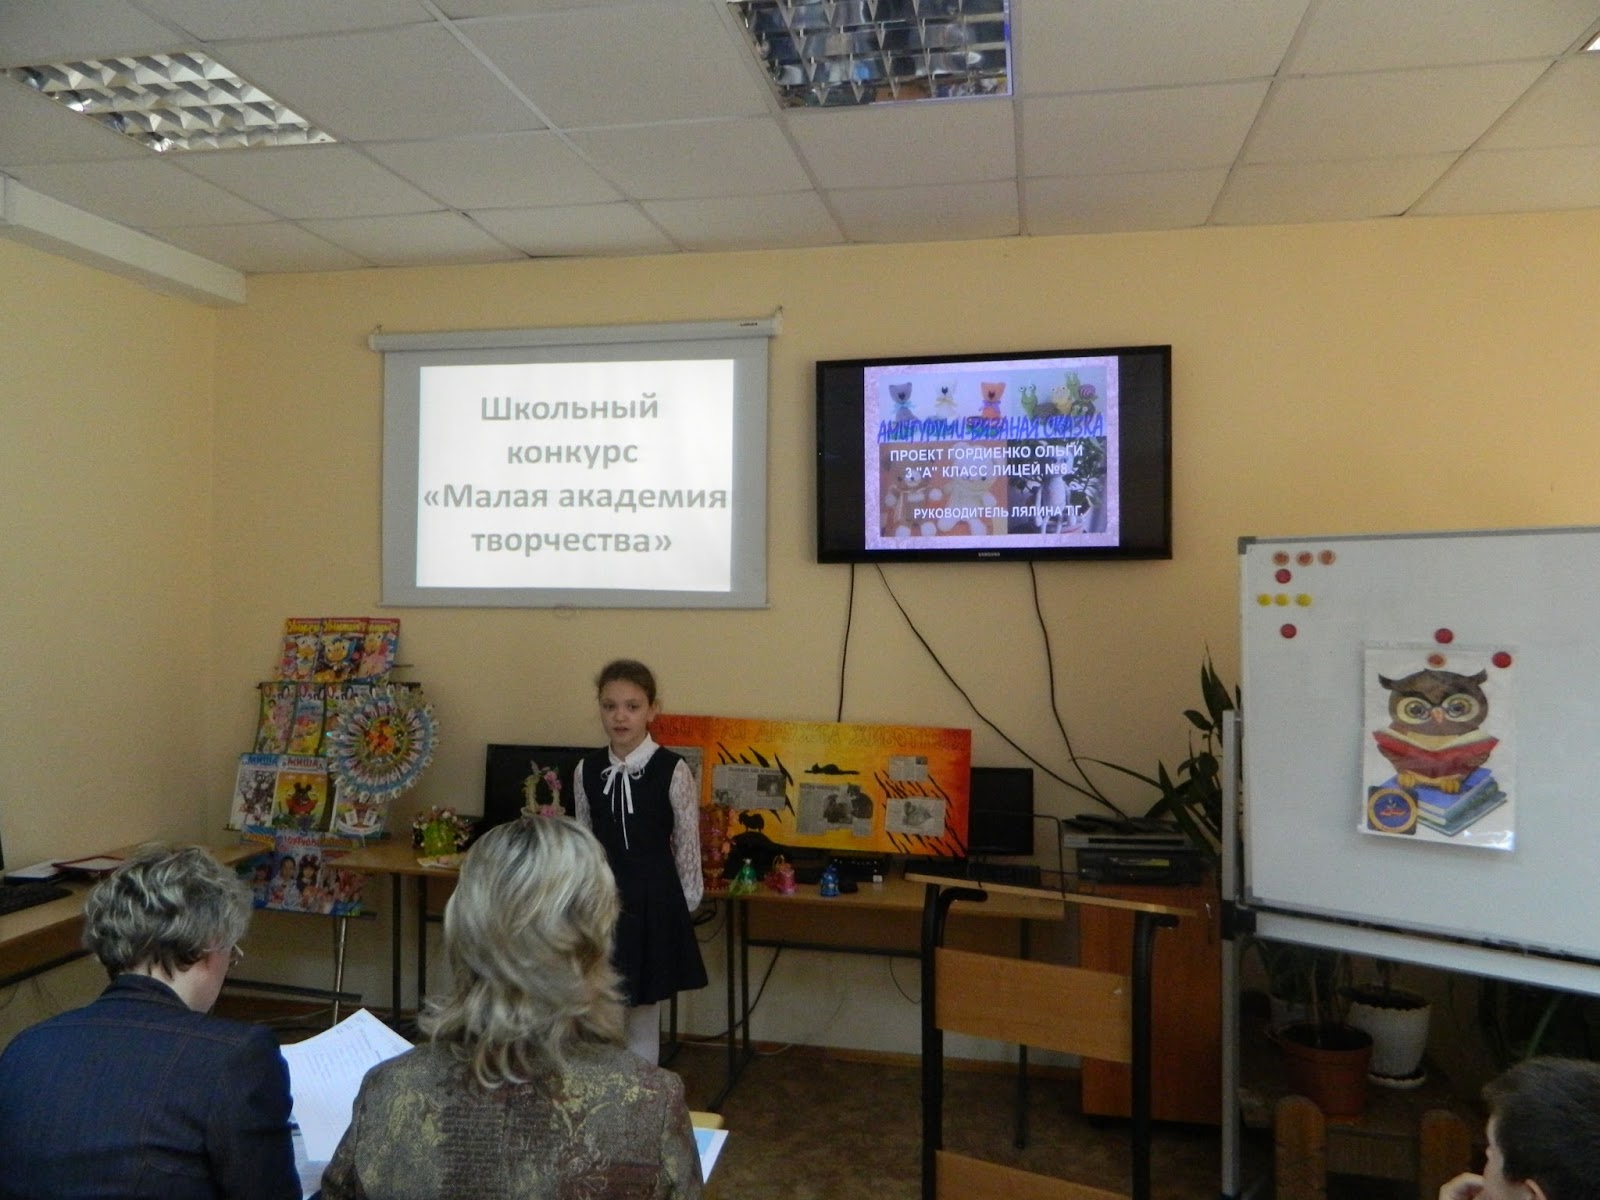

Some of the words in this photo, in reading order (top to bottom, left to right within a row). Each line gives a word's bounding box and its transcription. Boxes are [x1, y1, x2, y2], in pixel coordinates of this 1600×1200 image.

[481, 392, 658, 422] Школьный
[1043, 412, 1103, 438] СКАЗКА
[507, 444, 638, 470] конкурс
[890, 449, 944, 462] ПРОЕКТ
[948, 446, 1031, 461] ГОРДИЕНКО
[1034, 444, 1083, 458] ОЛЬГИ
[905, 467, 913, 479] 3
[942, 465, 988, 478] КЛАСС
[993, 461, 1041, 478] ЛИЦЕЙ
[1045, 462, 1068, 475] №8
[424, 484, 548, 509] «Малая
[558, 483, 727, 513] академия
[914, 506, 1009, 519] РУКОВОДИТЕЛЬ
[1011, 505, 1062, 517] ЛЯЛИНА
[472, 531, 672, 557] творчества»
